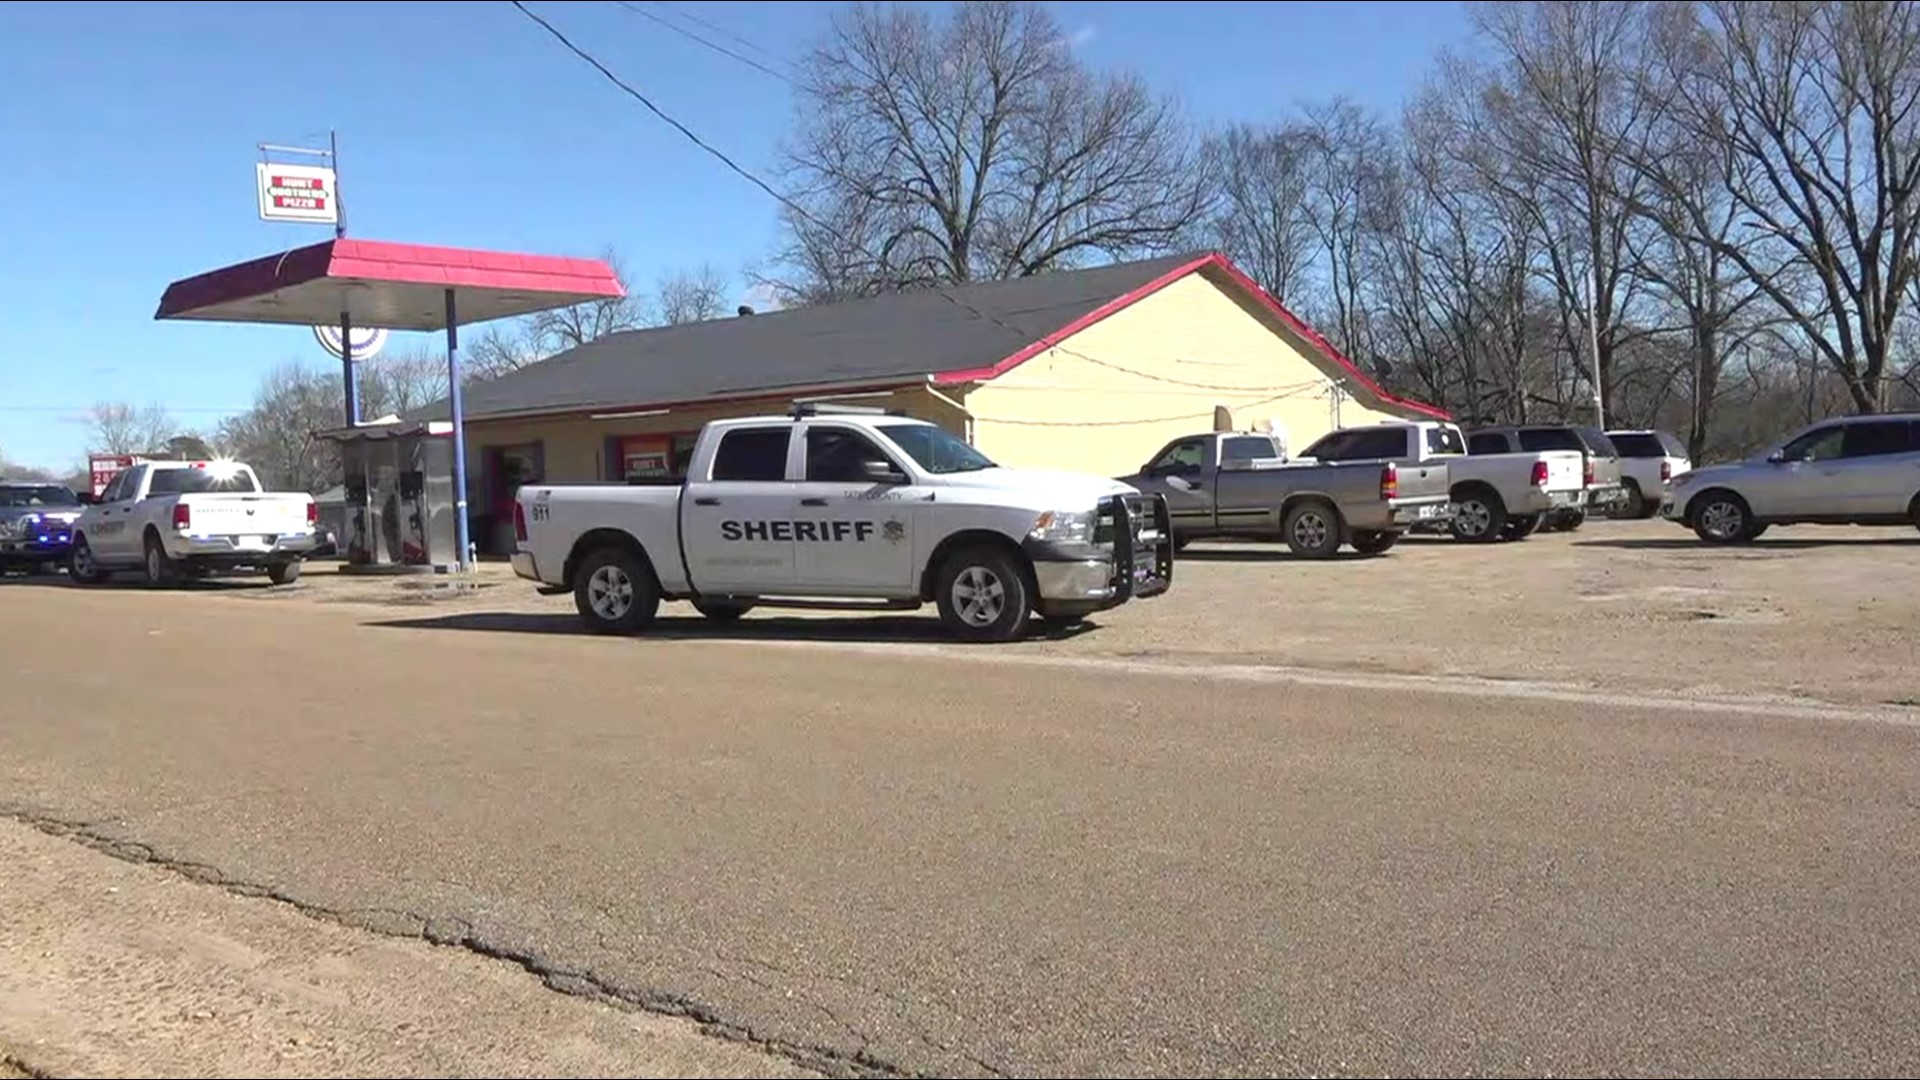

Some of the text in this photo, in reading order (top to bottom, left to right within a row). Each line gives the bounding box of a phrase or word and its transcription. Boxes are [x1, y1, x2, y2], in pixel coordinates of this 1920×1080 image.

[282, 197, 316, 209] PIZZA
[533, 503, 550, 521] 911
[721, 520, 874, 542] SHERIFF
